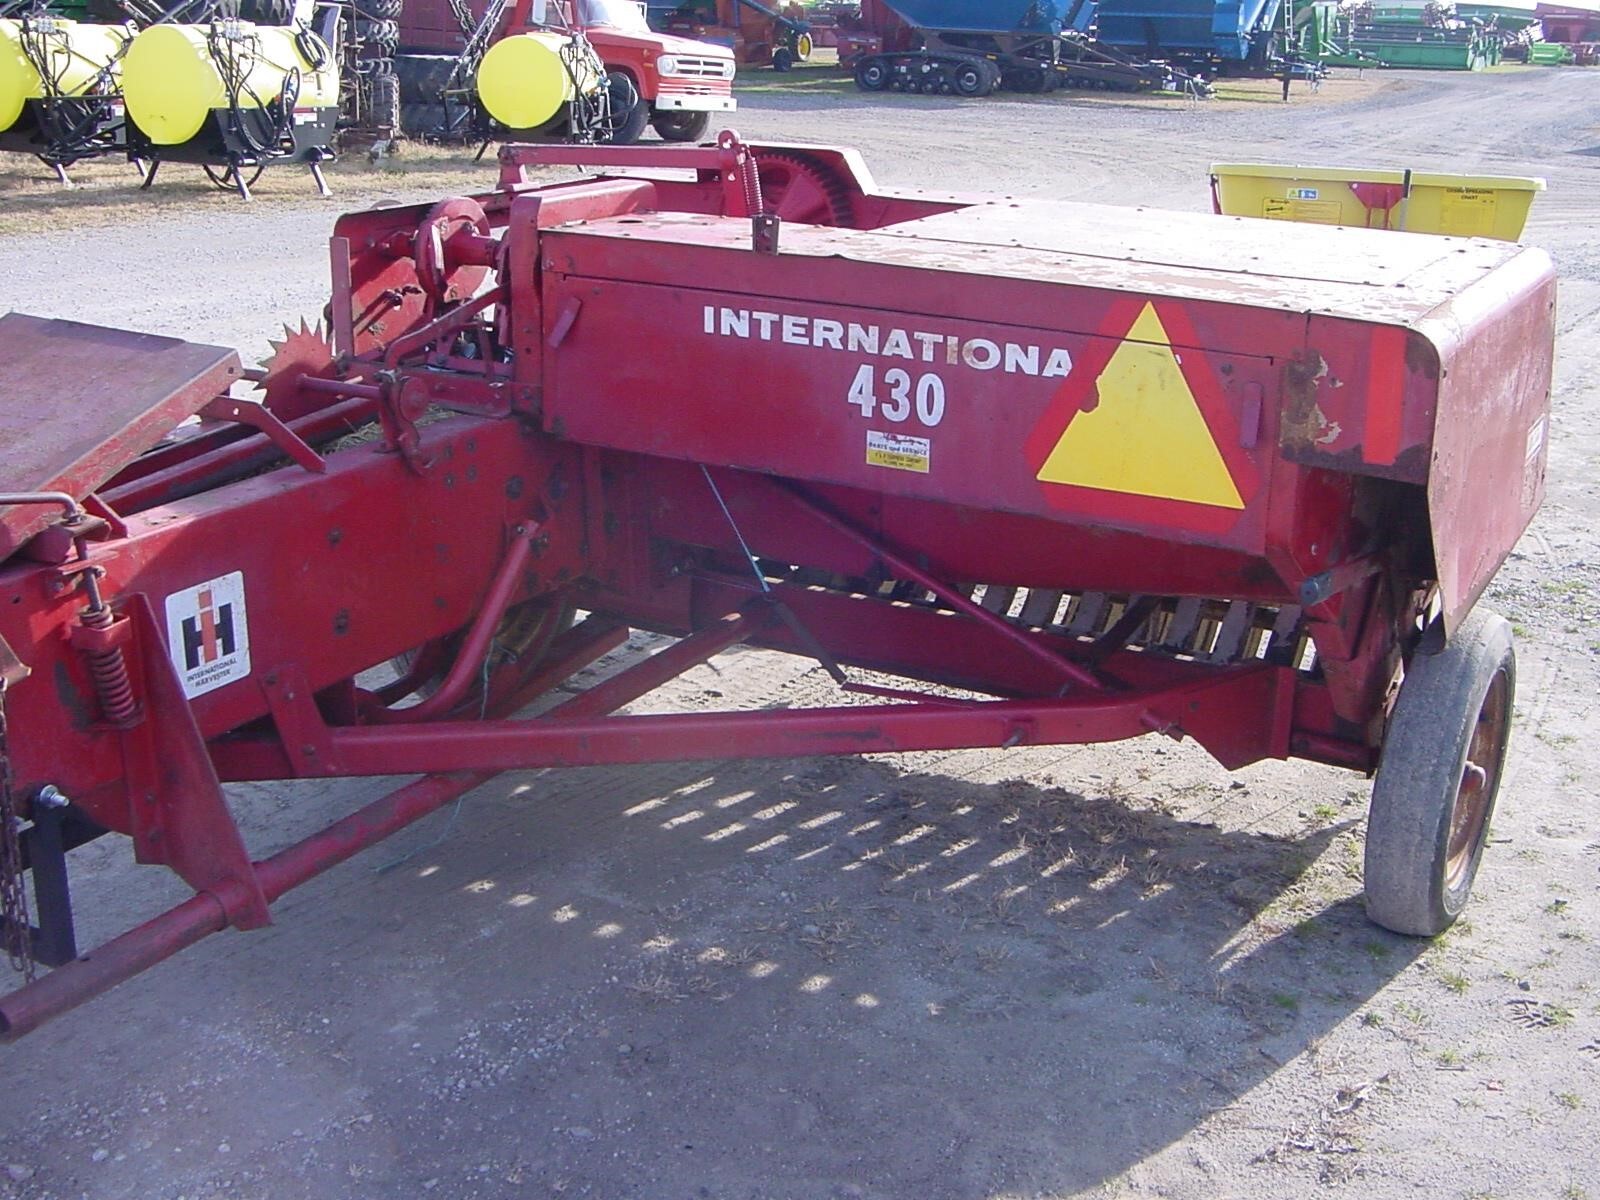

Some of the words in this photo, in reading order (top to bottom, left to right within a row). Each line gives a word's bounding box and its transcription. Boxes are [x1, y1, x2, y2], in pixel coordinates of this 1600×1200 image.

[847, 364, 946, 427] 430
[187, 657, 237, 682] INTERNATIONAL
[195, 668, 231, 687] HARVESTER
